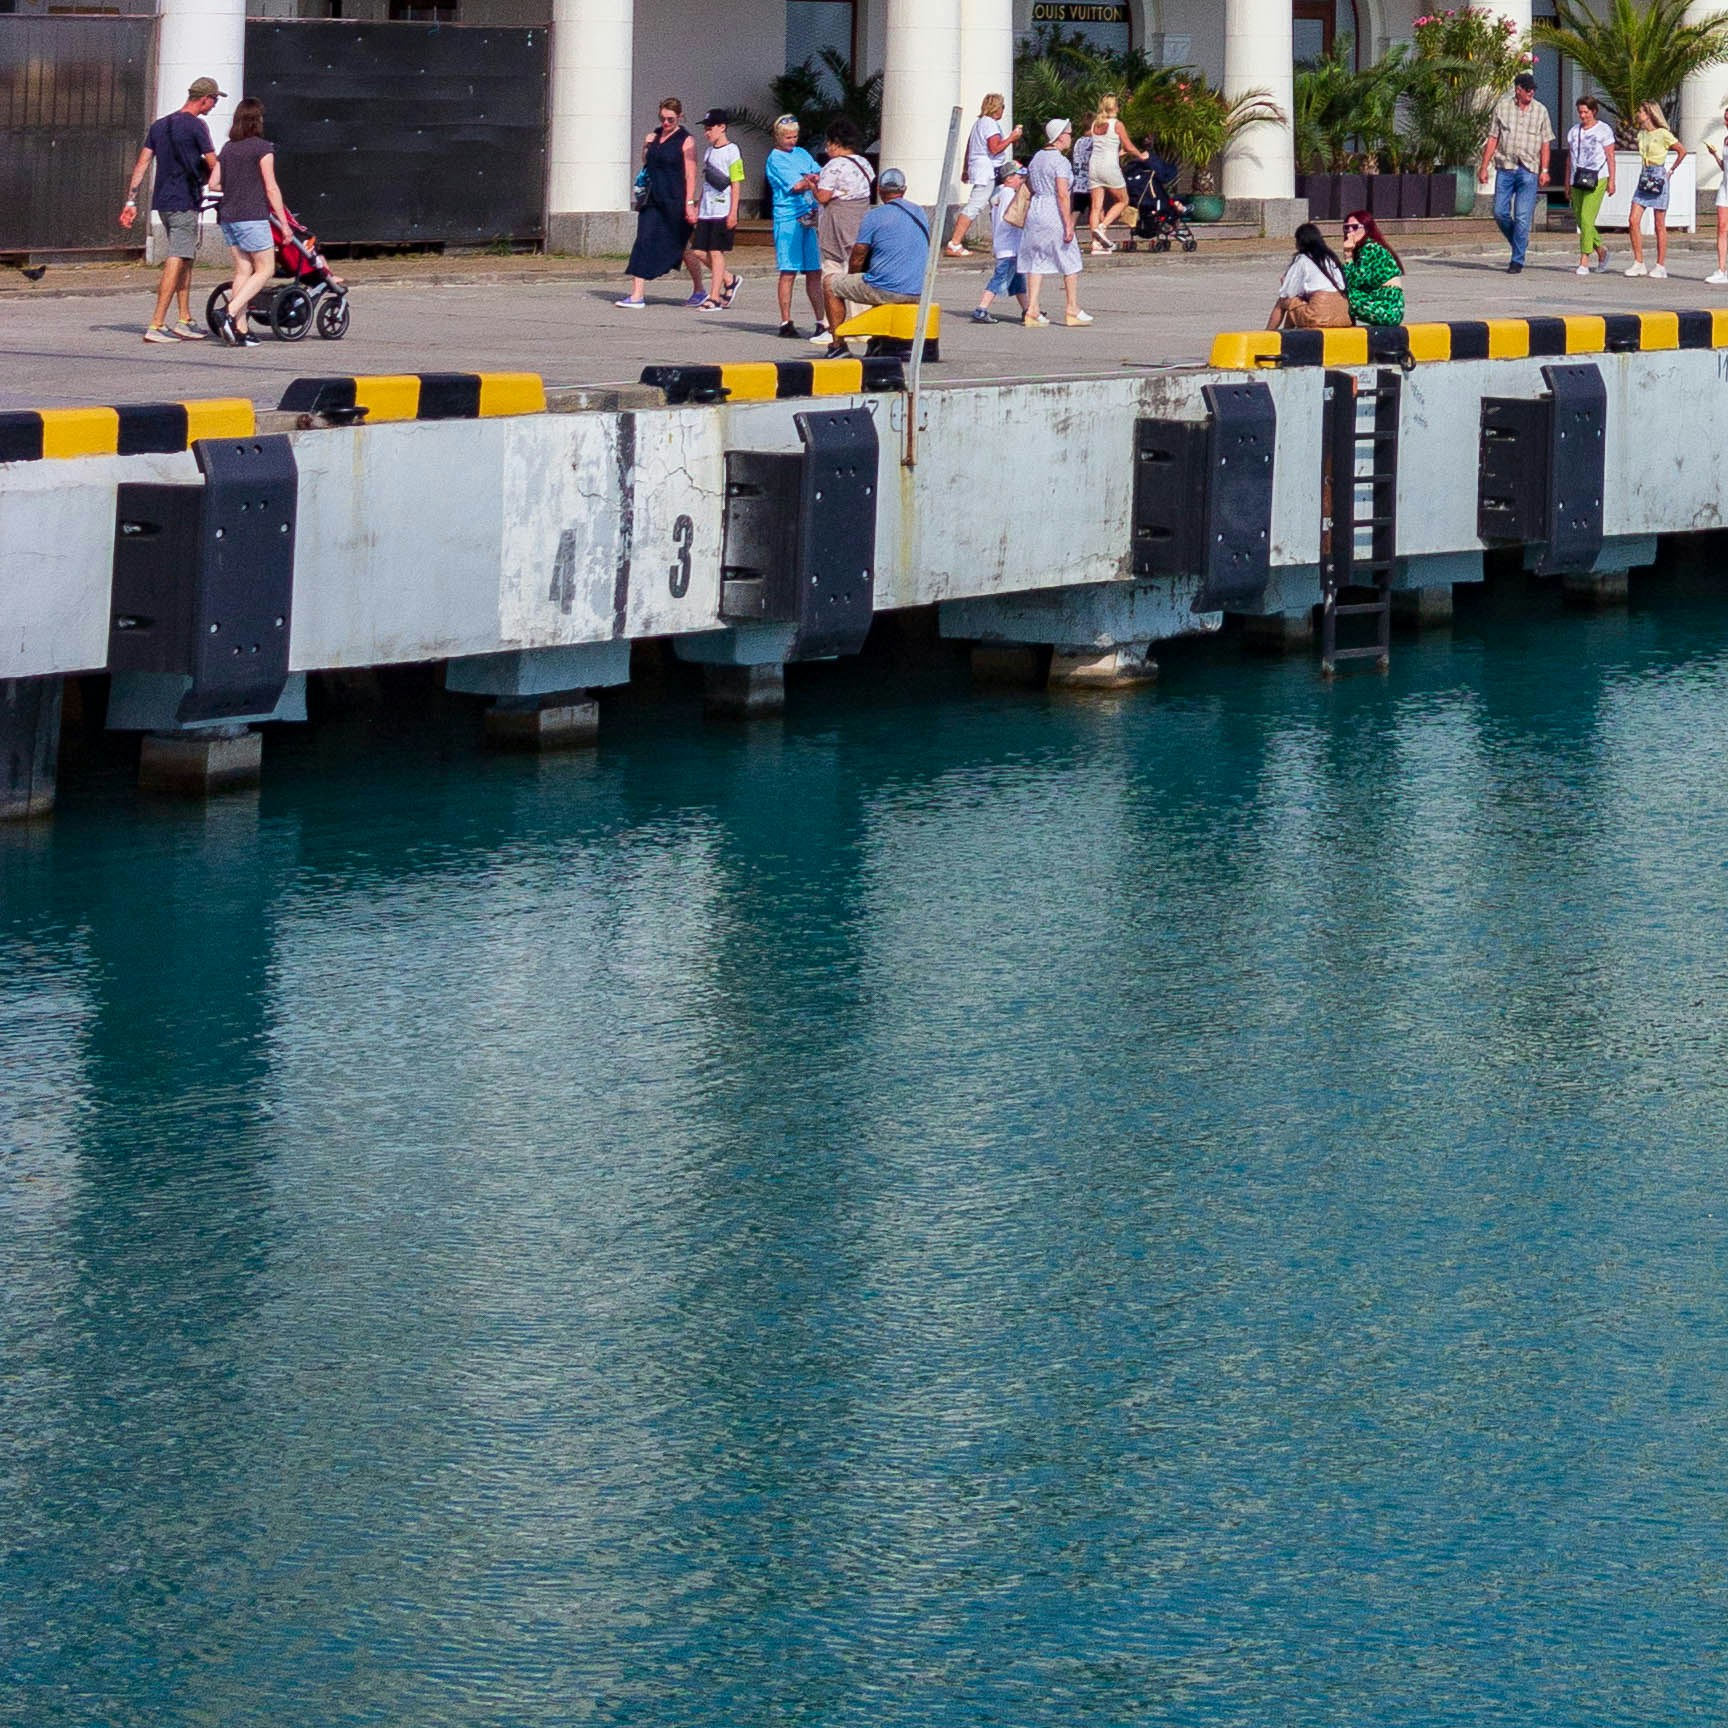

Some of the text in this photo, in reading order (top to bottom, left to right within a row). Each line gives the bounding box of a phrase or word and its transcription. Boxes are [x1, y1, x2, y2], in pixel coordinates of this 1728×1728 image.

[1034, 5, 1122, 21] OUIS VUITTON
[669, 514, 694, 598] 3
